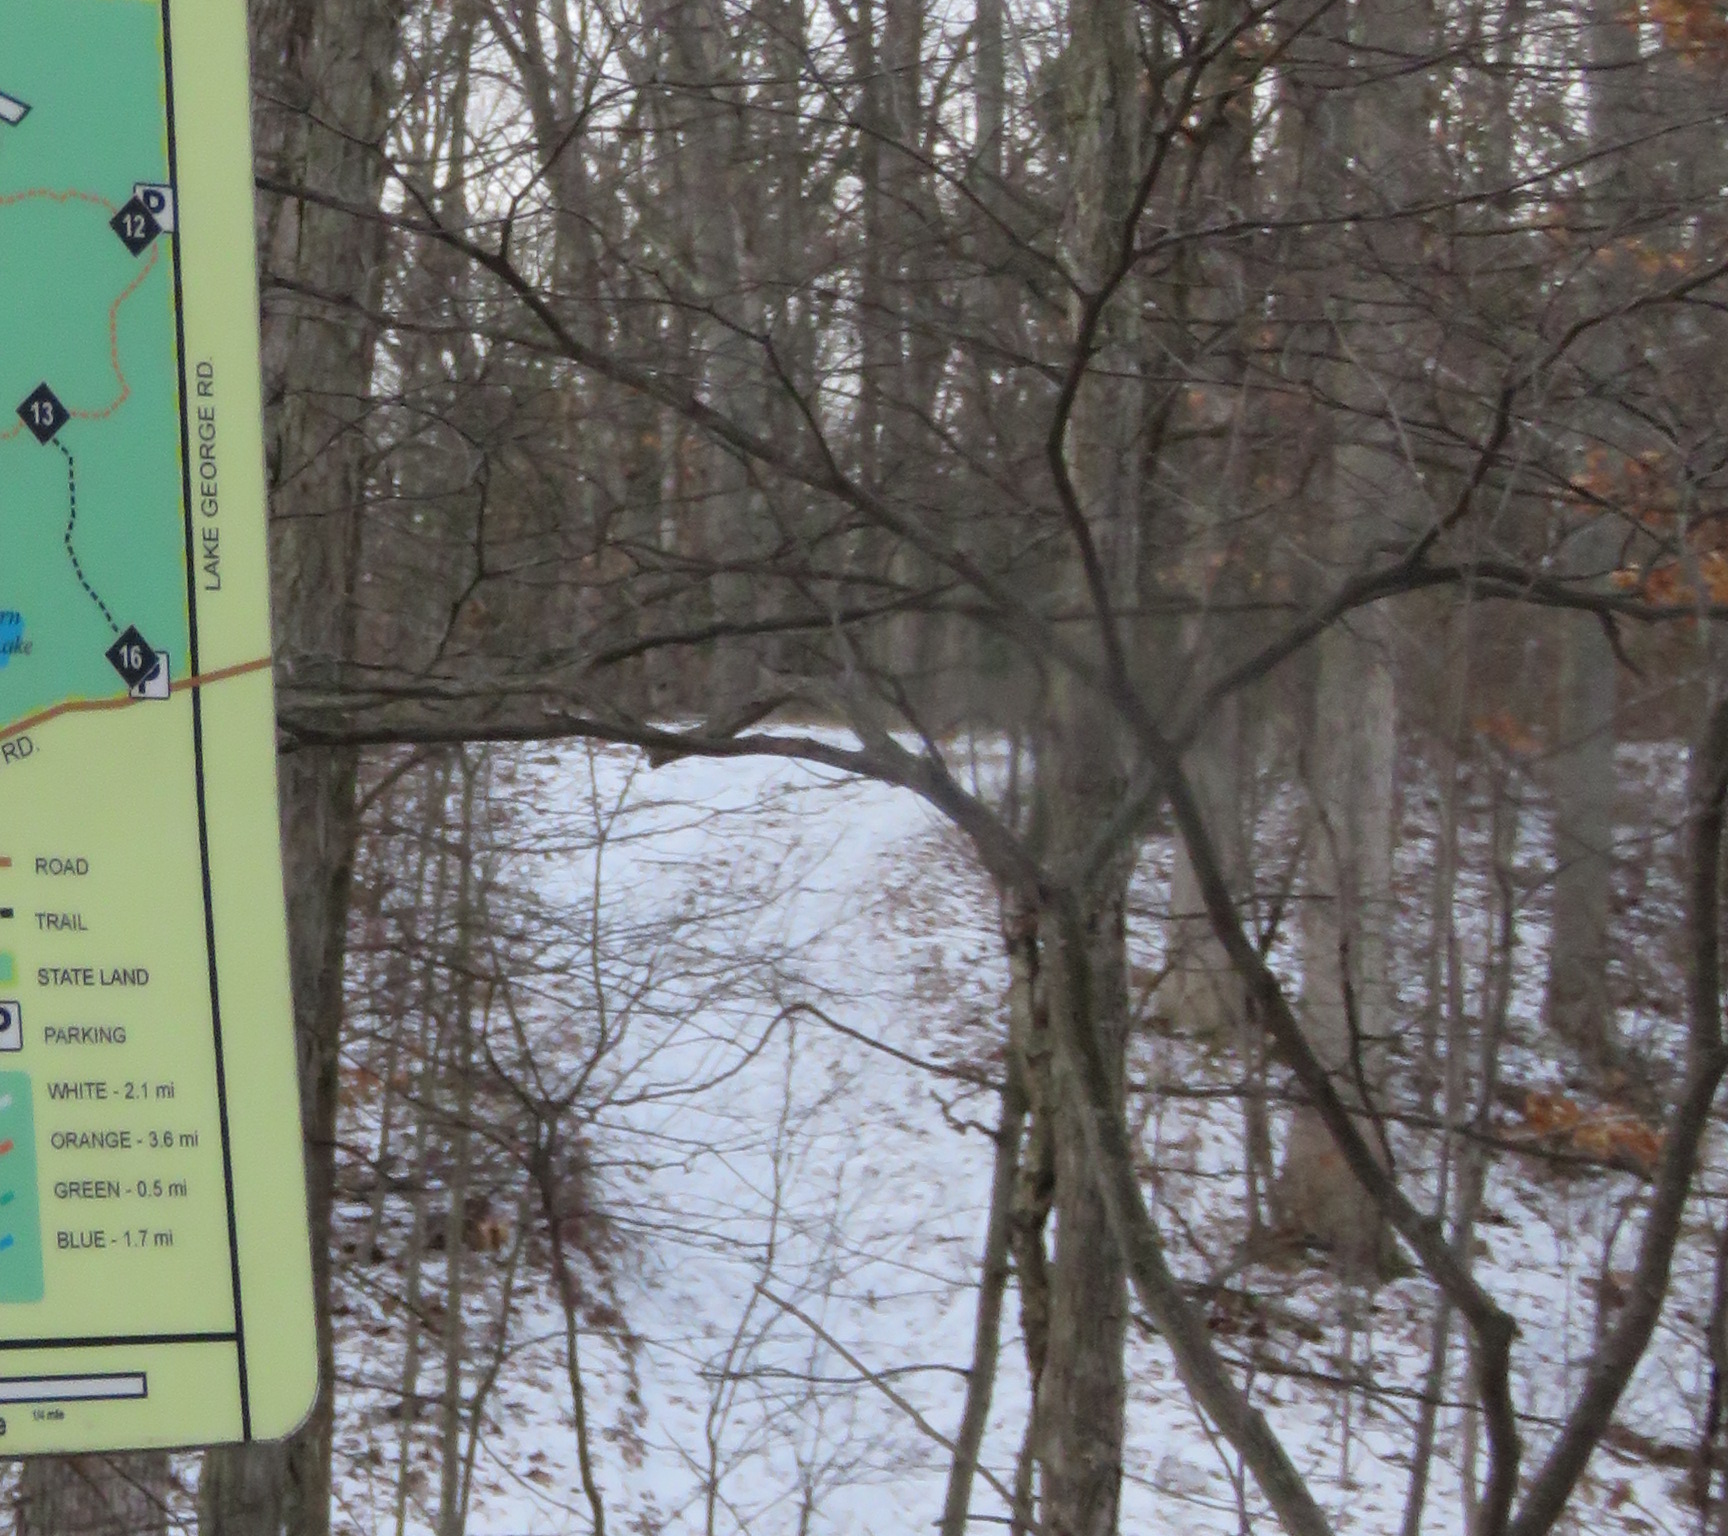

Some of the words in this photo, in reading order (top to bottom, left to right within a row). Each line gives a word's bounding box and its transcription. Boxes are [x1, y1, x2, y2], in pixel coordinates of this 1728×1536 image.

[122, 213, 146, 238] 12
[196, 355, 214, 398] RD.
[30, 400, 55, 427] 13
[198, 405, 219, 519] GEORGE
[204, 526, 222, 592] LAKE
[119, 644, 143, 670] 16
[1, 735, 40, 763] RD.
[35, 857, 89, 876] ROAD
[35, 912, 88, 931] TRAIL
[37, 967, 95, 986] STATE
[100, 967, 150, 986] LAND
[44, 1026, 126, 1045] PARKING
[47, 1081, 108, 1100] WHITE
[124, 1081, 149, 1099] 2.1
[155, 1080, 175, 1099] mi
[51, 1131, 132, 1150] ORANGE
[148, 1130, 174, 1148] 3.6
[178, 1130, 199, 1148] mi
[54, 1180, 122, 1200] GREEN
[136, 1179, 164, 1198] 0.5
[168, 1178, 188, 1198] mi
[57, 1230, 106, 1250] BLUE
[122, 1229, 148, 1248] 1.7
[153, 1228, 174, 1247] mi
